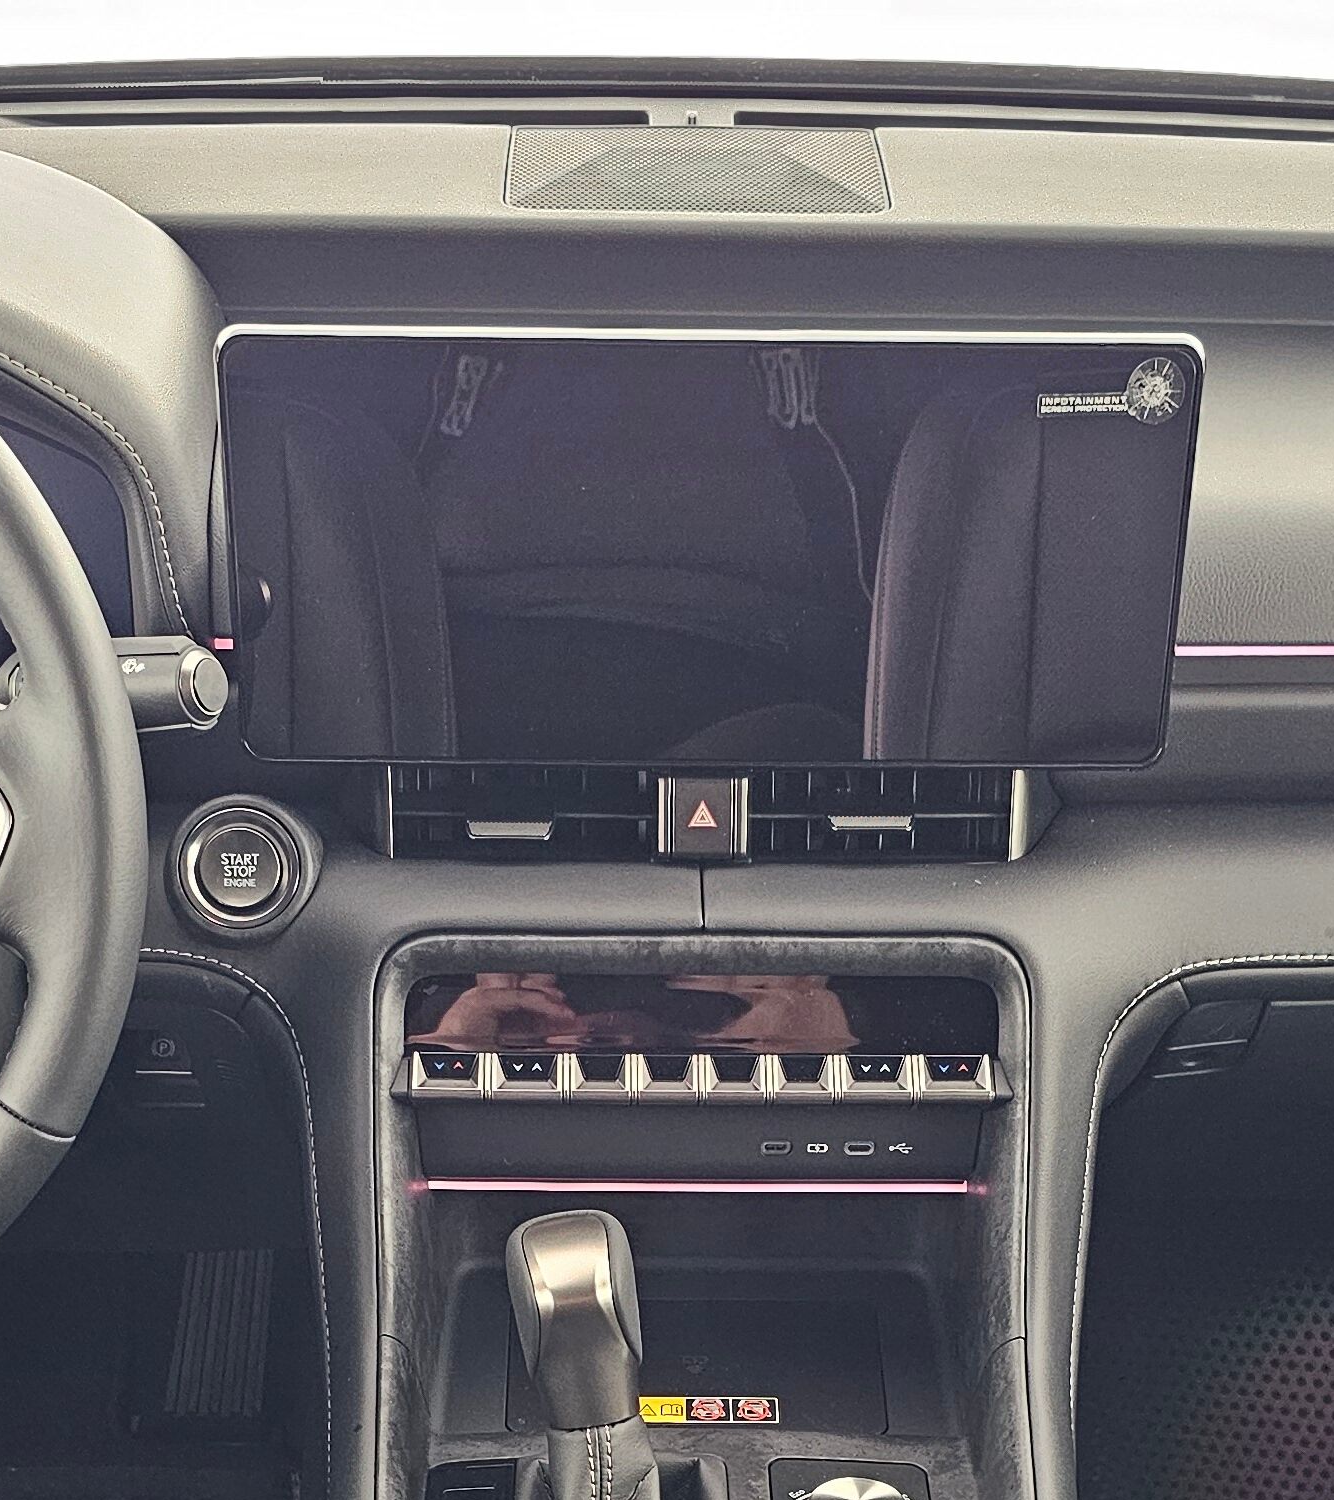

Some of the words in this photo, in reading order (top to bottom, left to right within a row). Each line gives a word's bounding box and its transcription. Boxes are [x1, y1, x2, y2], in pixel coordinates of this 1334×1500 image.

[220, 852, 260, 866] START
[223, 865, 257, 878] STOP
[223, 878, 257, 888] ENGINE
